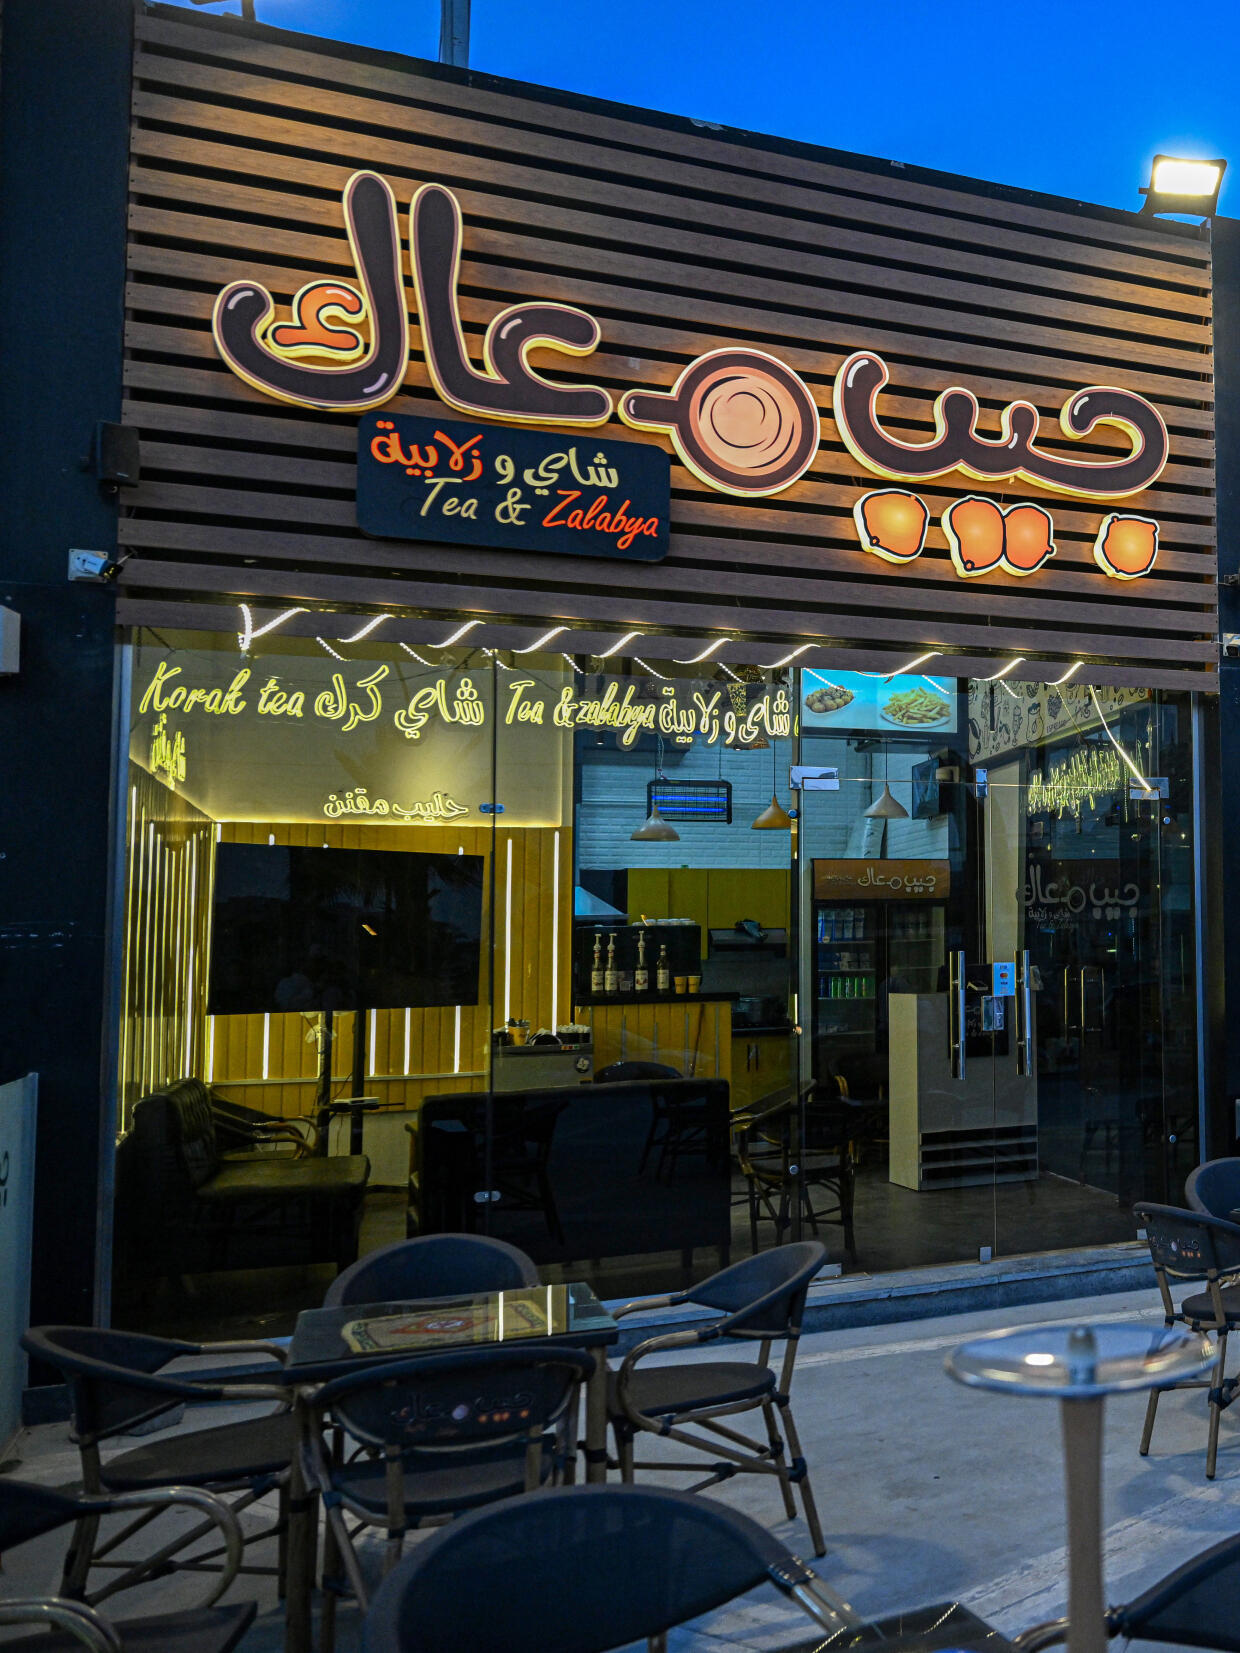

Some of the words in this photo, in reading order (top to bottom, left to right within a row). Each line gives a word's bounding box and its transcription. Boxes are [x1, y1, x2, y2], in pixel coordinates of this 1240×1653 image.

[370, 420, 484, 481] زلابية
[494, 454, 516, 485] و
[523, 447, 619, 496] شاي
[419, 477, 478, 519] Tea
[494, 487, 532, 525] &
[541, 489, 659, 550] Zalabya
[257, 678, 306, 718] tea
[314, 664, 390, 732] كرك
[394, 677, 485, 739] شاي
[505, 680, 545, 725] Tea
[553, 686, 579, 728] &
[575, 681, 656, 745] zalabya
[658, 687, 722, 744] زلابية
[724, 711, 737, 745] و
[323, 788, 390, 818] مقنن
[393, 793, 469, 822] حليب
